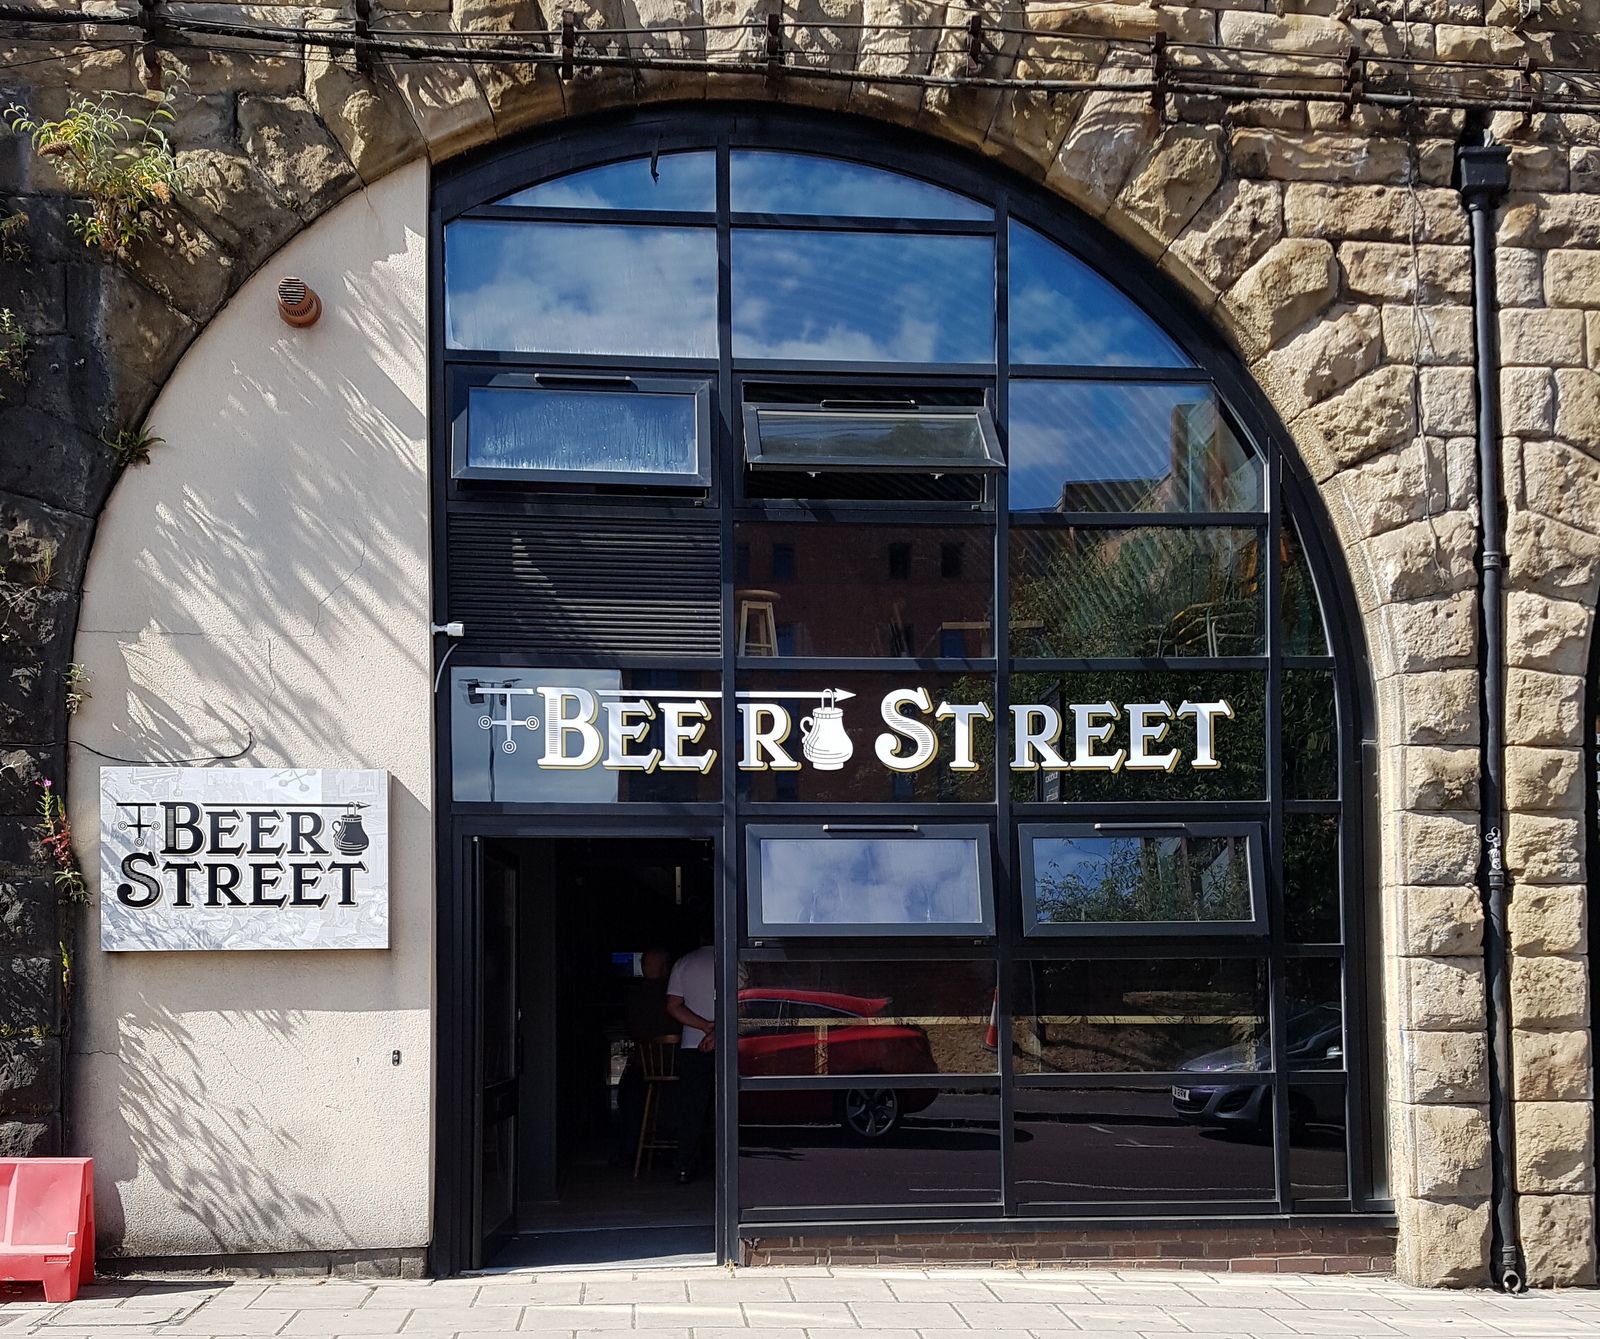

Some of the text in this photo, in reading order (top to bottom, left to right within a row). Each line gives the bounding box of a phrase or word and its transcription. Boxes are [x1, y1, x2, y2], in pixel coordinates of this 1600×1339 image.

[536, 686, 1235, 774] BEER STREET
[159, 801, 331, 857] BEER
[116, 851, 368, 909] STREET
